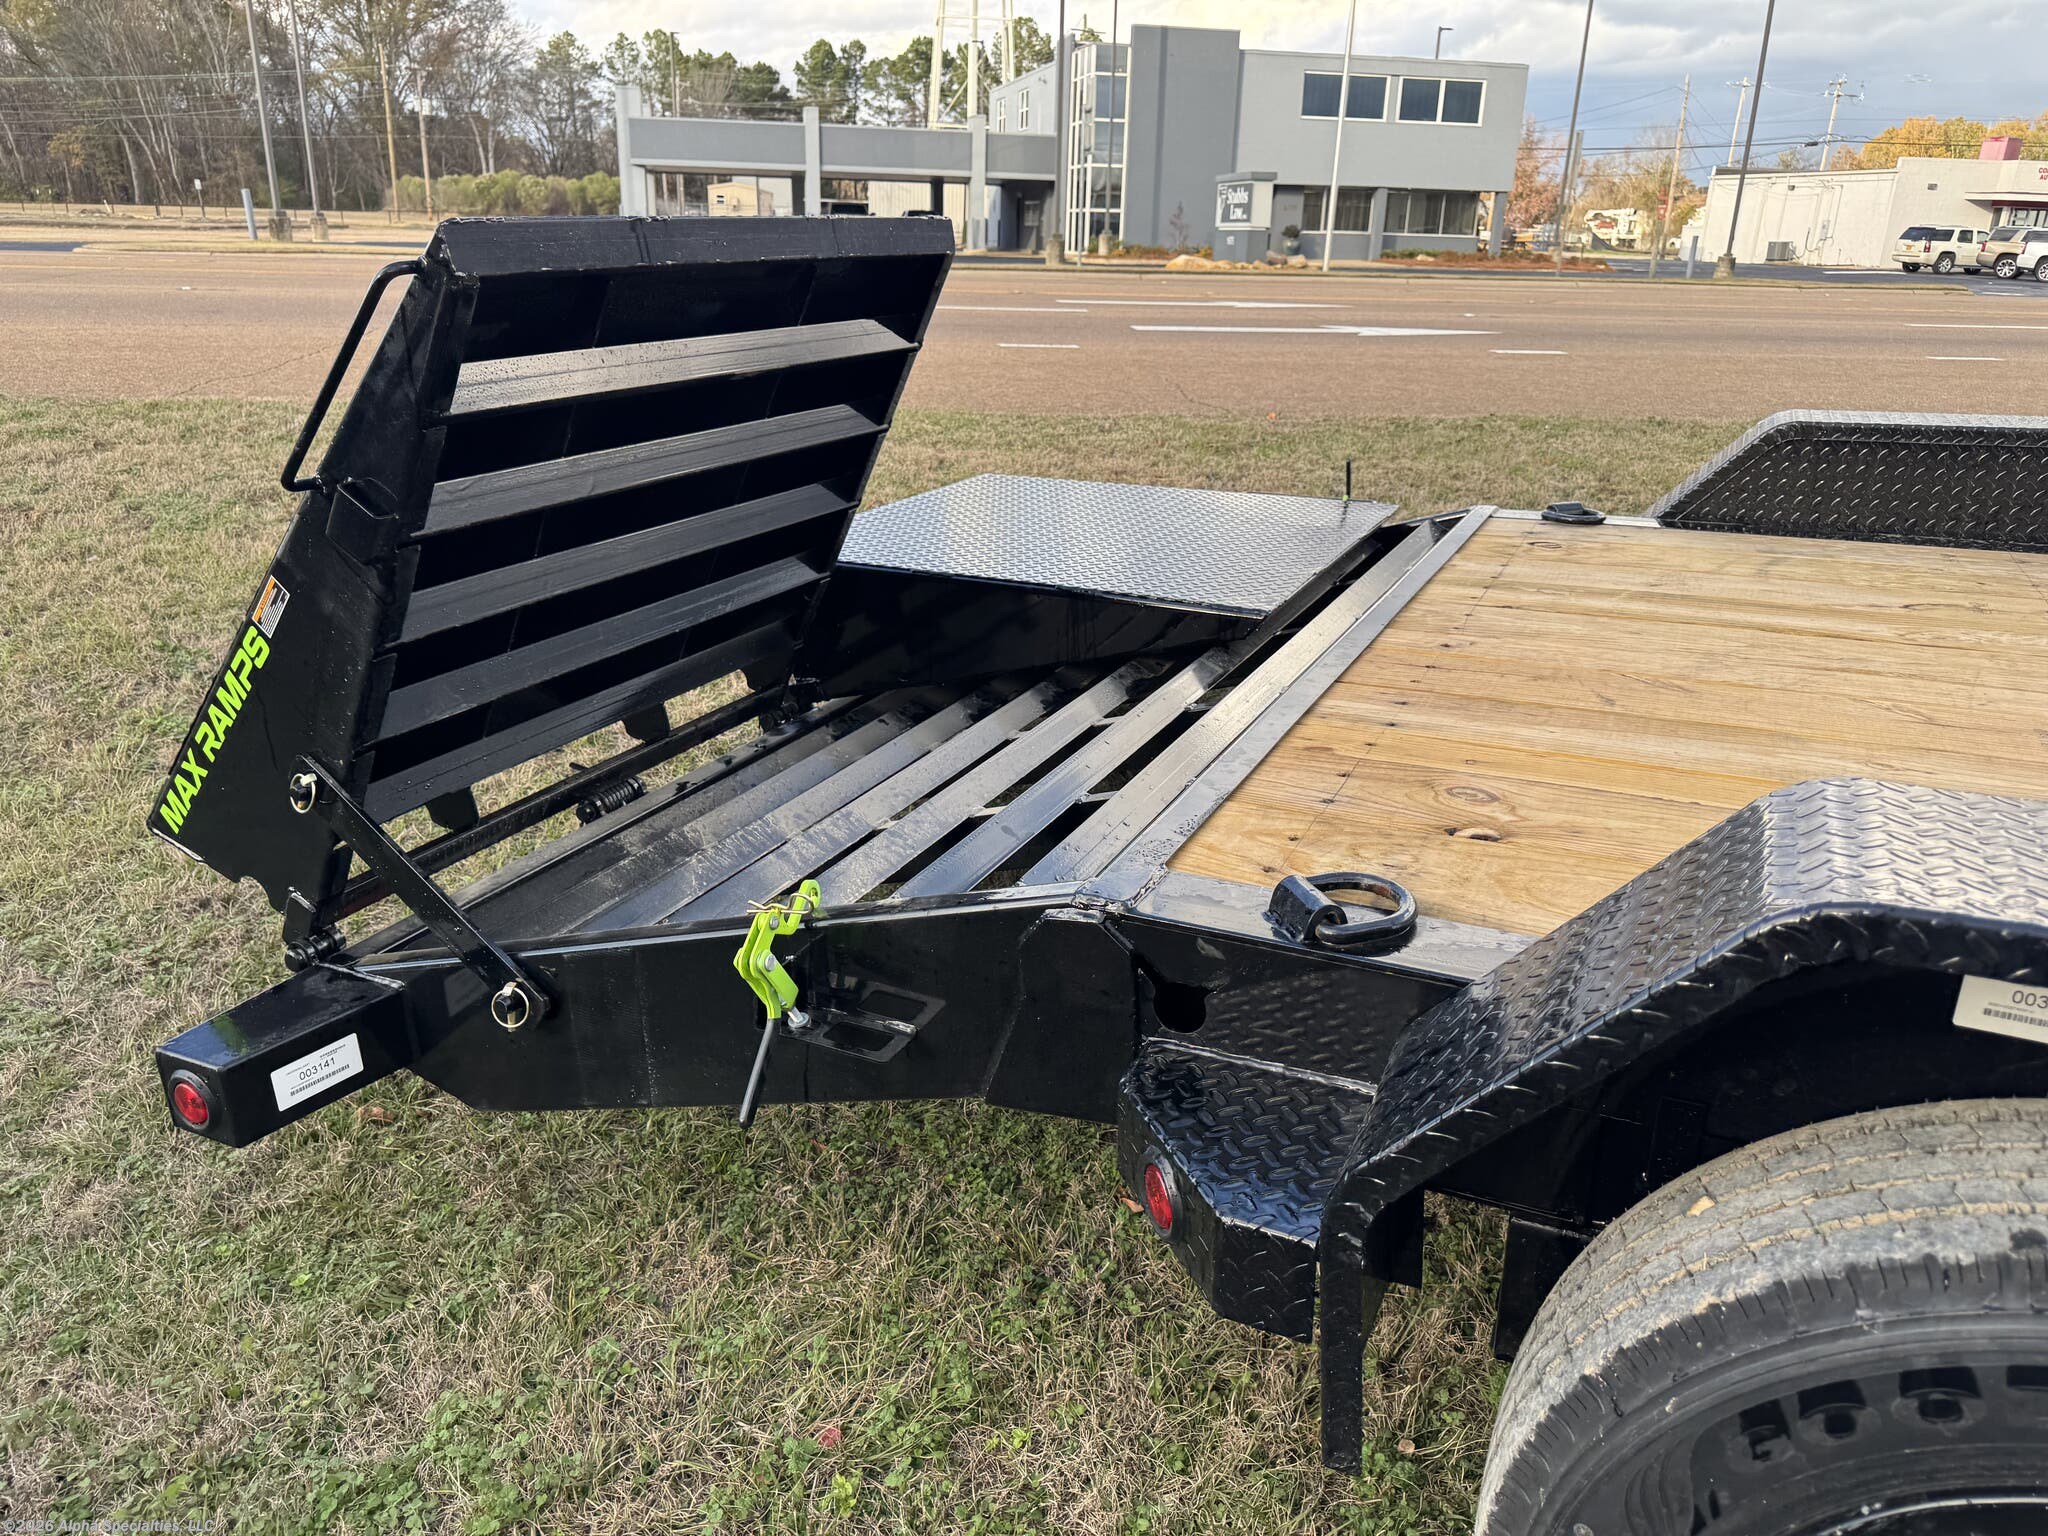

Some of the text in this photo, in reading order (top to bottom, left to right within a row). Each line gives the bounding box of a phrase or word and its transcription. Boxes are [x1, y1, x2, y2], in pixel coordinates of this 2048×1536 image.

[159, 625, 270, 835] MAX RAMPS
[299, 1056, 336, 1081] 003141
